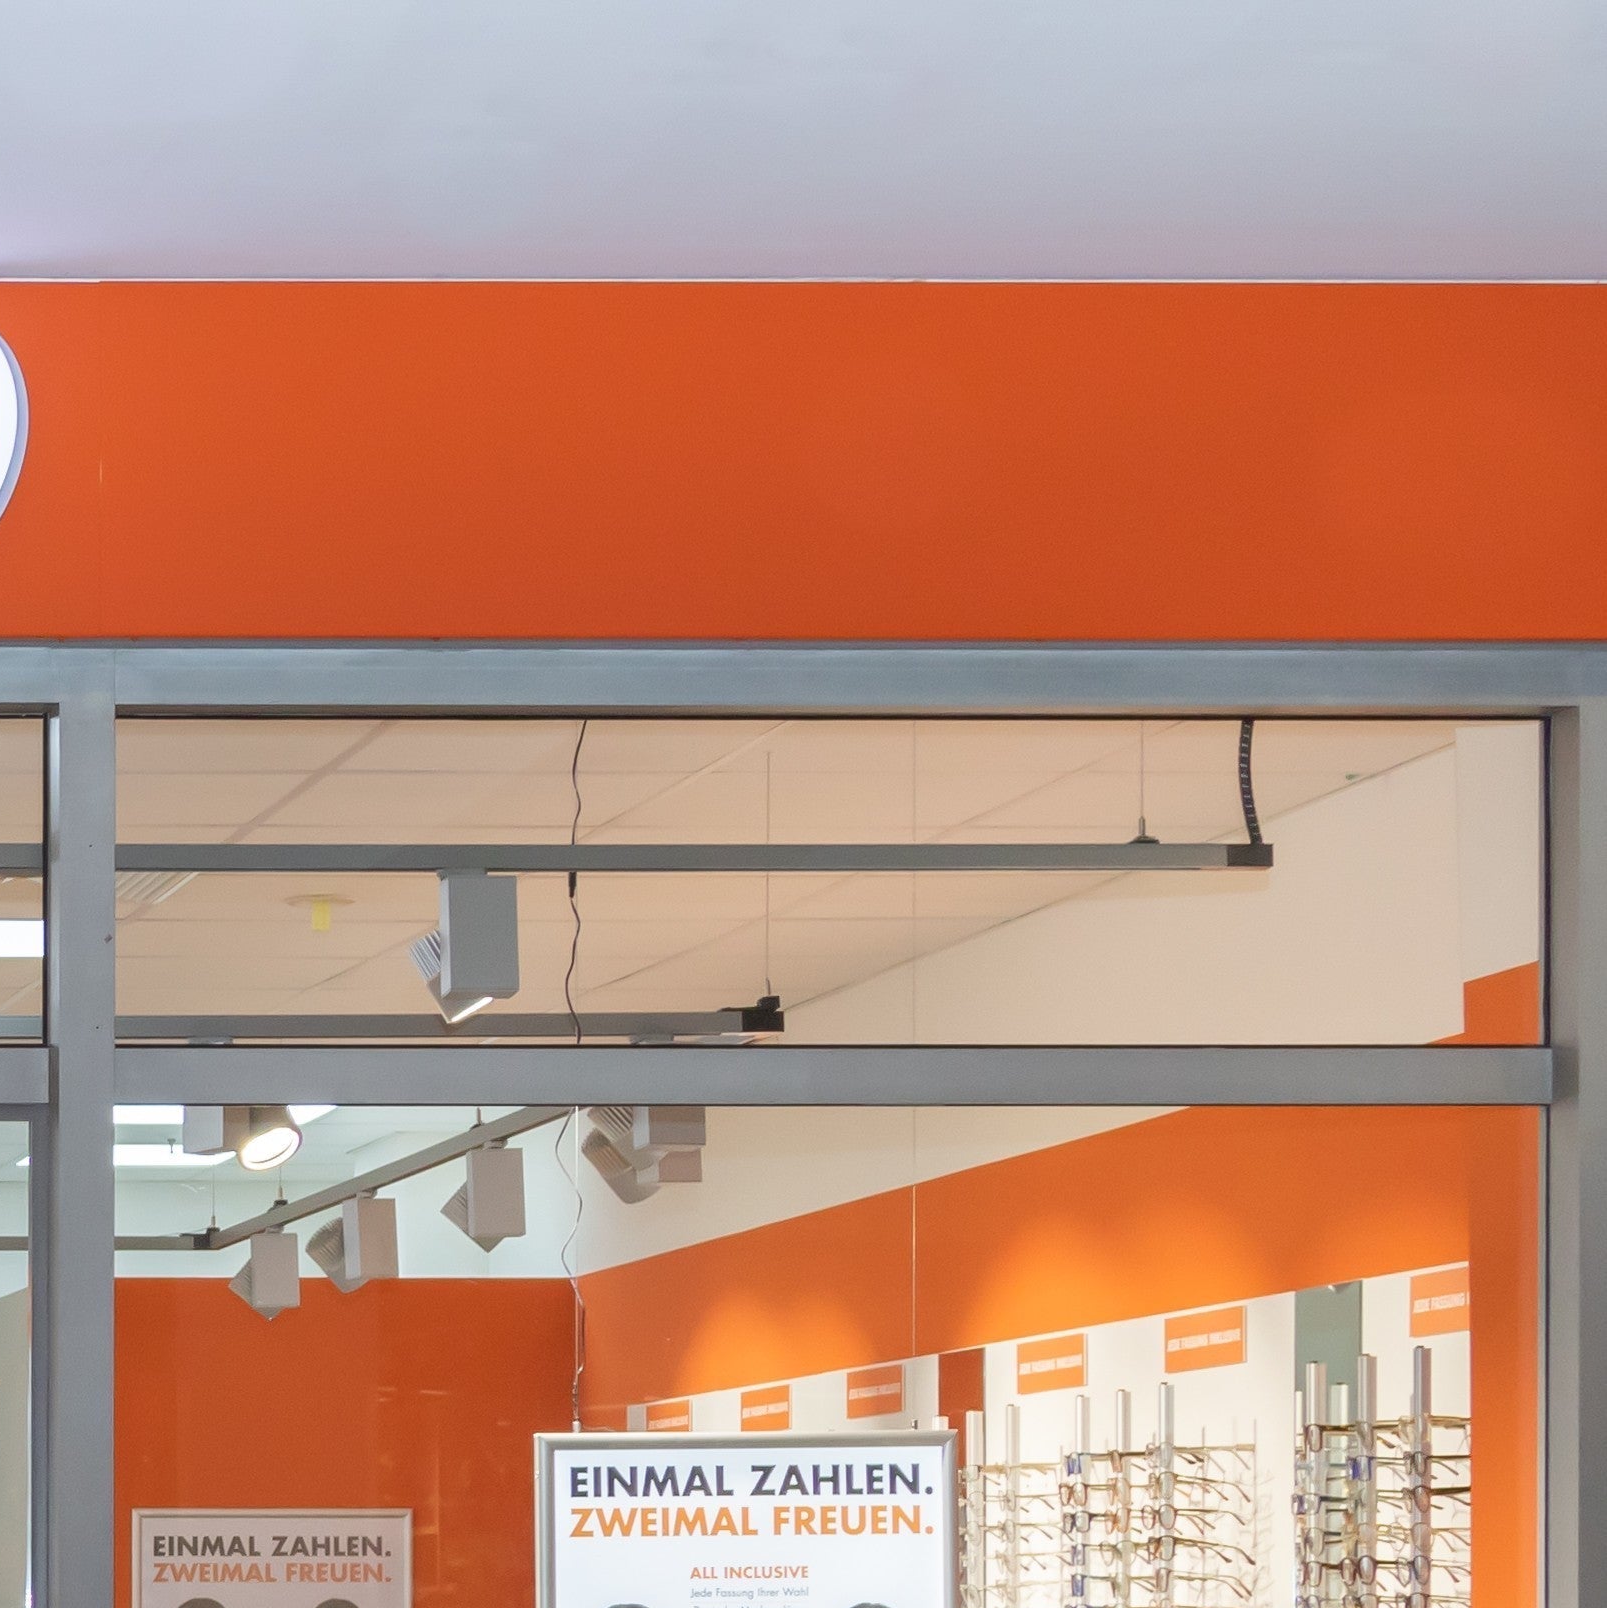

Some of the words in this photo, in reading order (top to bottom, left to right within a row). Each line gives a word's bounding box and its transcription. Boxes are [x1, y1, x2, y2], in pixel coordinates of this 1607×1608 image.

[570, 1465, 736, 1498] EINMAL
[750, 1463, 934, 1497] ZAHLEN.
[570, 1506, 758, 1538] ZWEIMAL
[773, 1504, 934, 1536] FREUEN.
[153, 1536, 261, 1557] EINMAL
[271, 1536, 392, 1557] ZAHLEN.
[153, 1562, 277, 1583] ZWEIMAL
[285, 1562, 392, 1583] FREUEN.
[690, 1567, 718, 1579] ALL
[724, 1566, 809, 1578] INCLUSIVE
[690, 1588, 712, 1598] Jede
[716, 1588, 754, 1600] Fassung
[758, 1587, 779, 1596] Ihrer
[783, 1587, 809, 1596] Wahl
